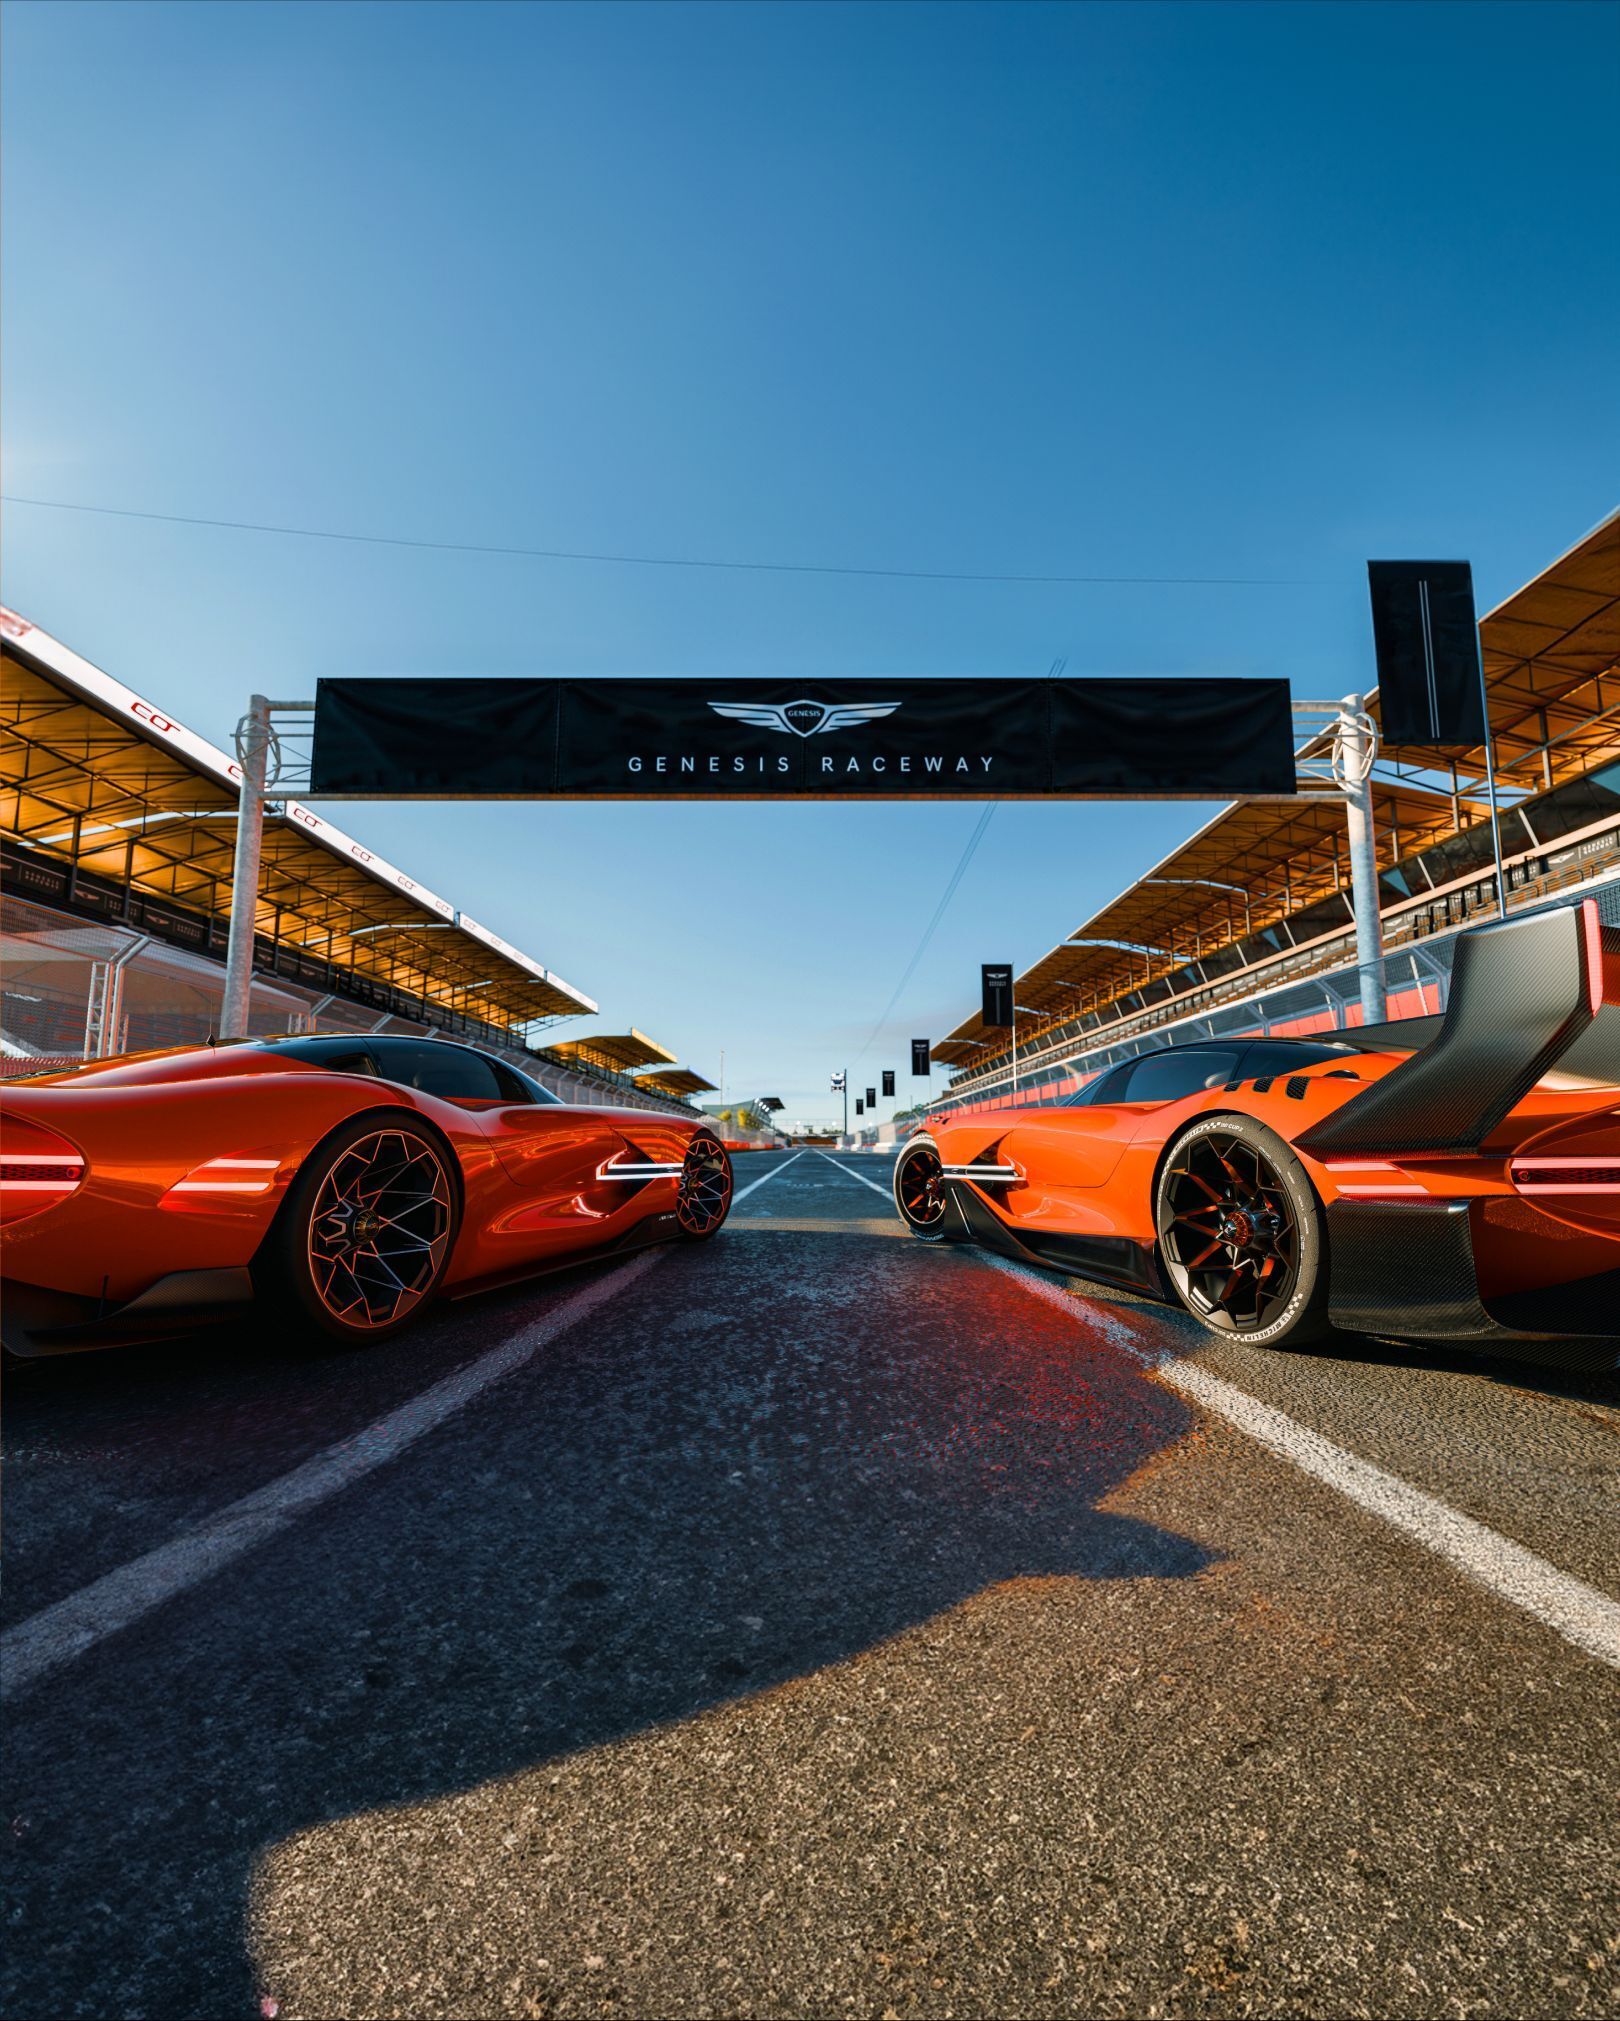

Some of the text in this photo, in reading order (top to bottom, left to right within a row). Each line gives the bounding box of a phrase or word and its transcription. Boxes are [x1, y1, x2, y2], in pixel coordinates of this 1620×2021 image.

[628, 756, 993, 772] GENESIS RACEWAY
[1246, 1320, 1283, 1341] MICHELIN
